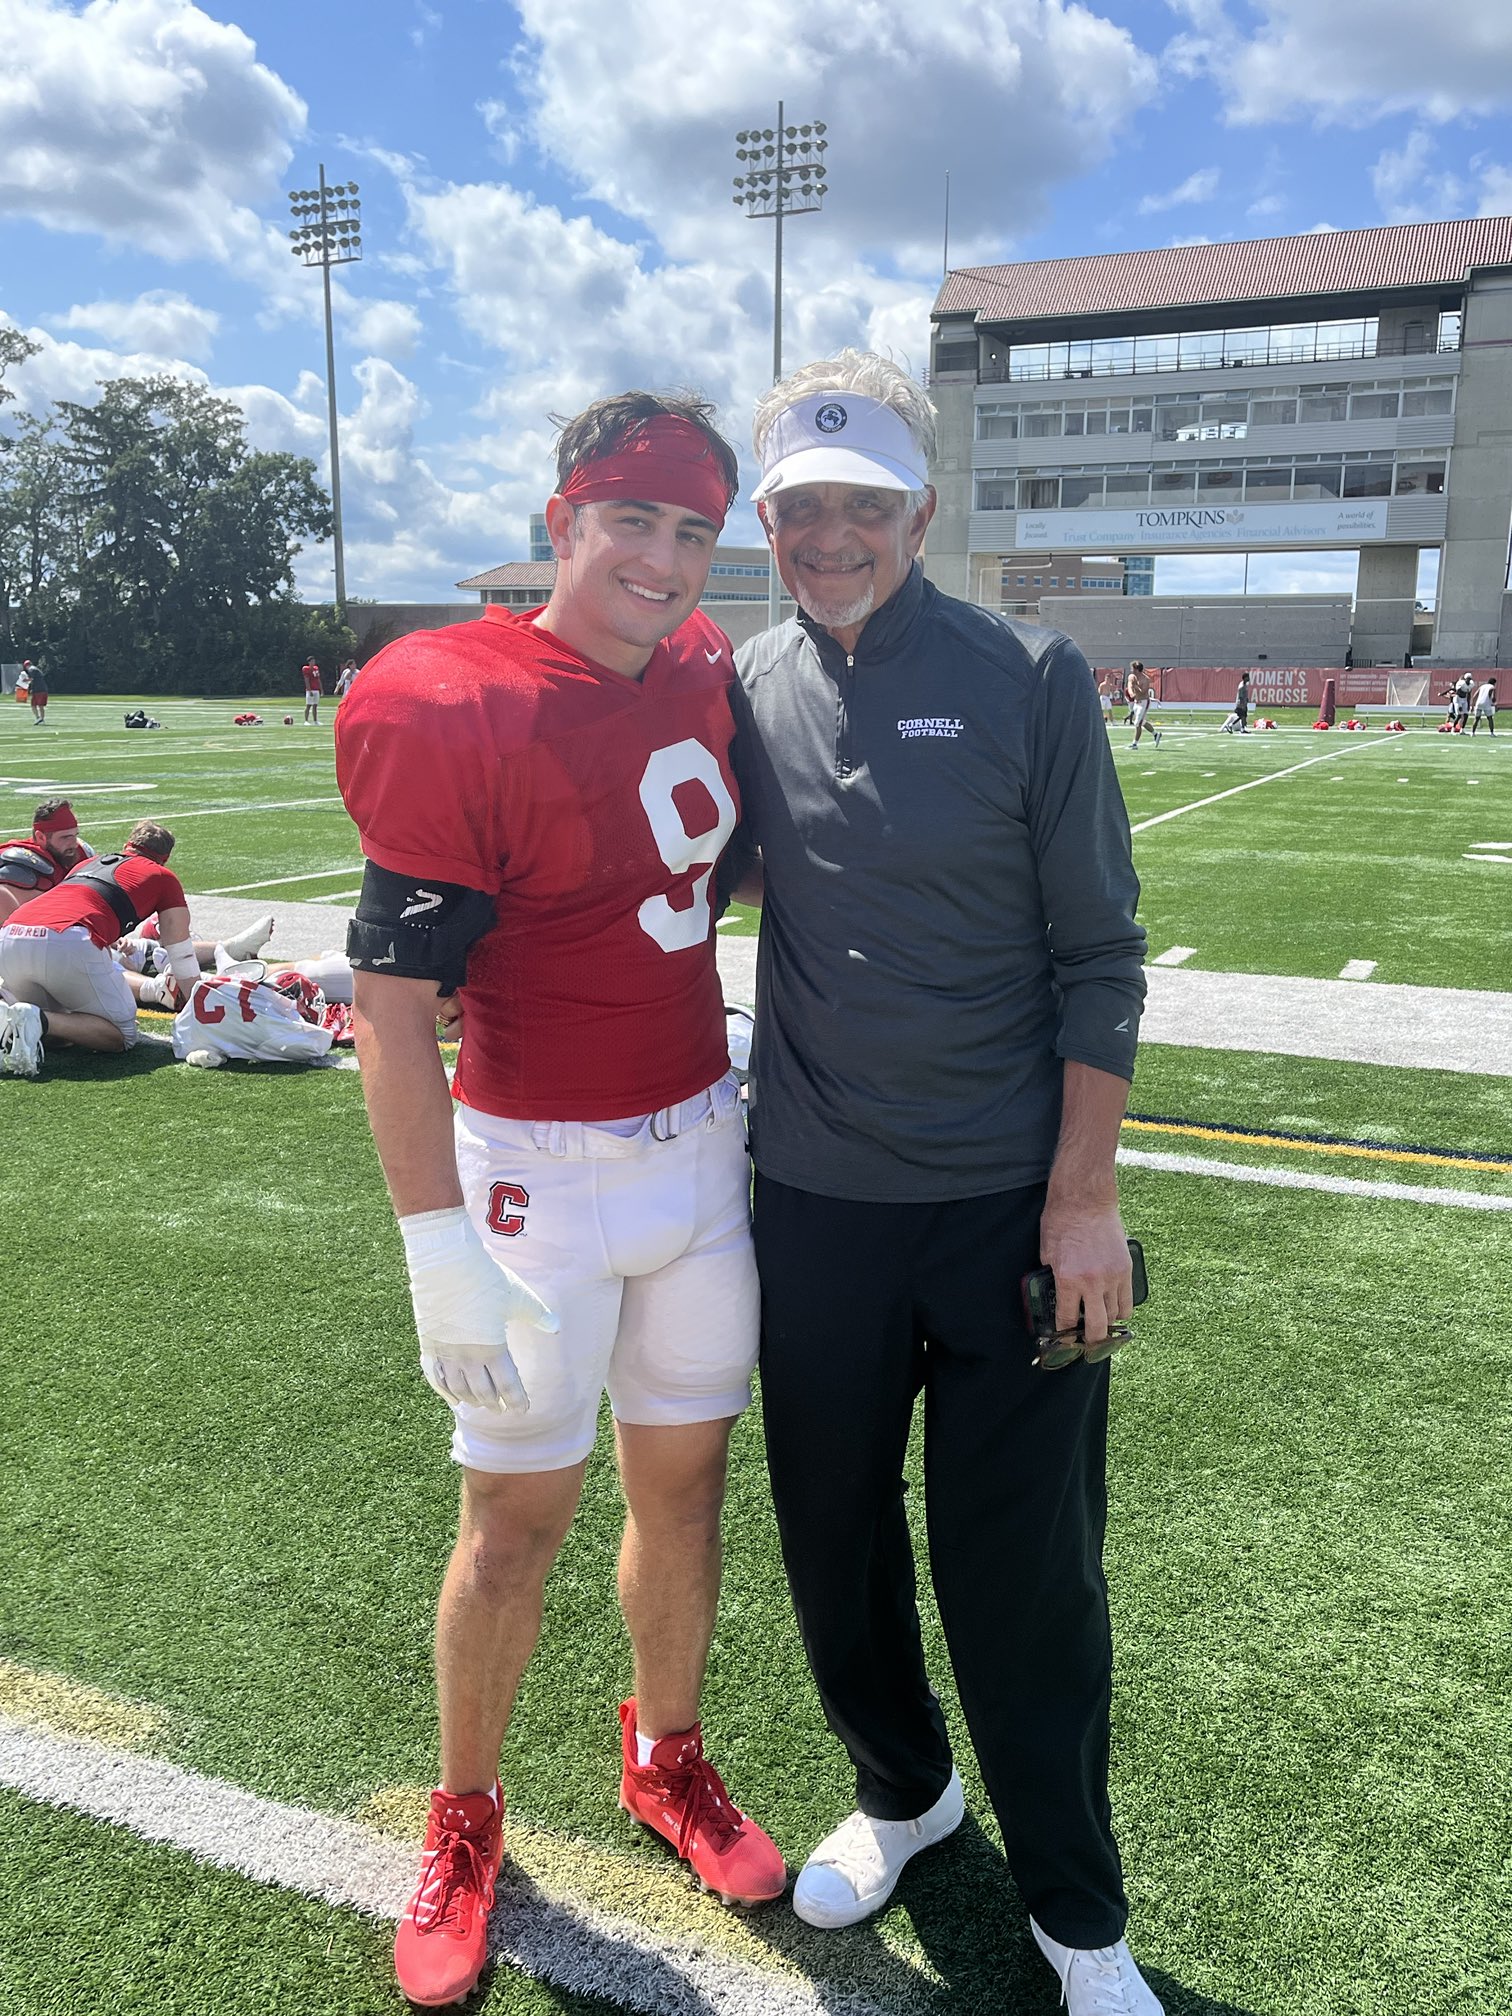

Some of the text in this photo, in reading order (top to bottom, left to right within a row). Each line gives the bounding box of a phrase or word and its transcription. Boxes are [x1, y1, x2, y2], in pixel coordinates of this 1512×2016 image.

[1136, 510, 1225, 528] TOMPKINS
[1345, 511, 1364, 519] world
[1366, 511, 1374, 521] of
[1063, 524, 1326, 544] Trust Company Insurance Agencies Financial Advisors
[1250, 687, 1309, 704] ACROSSE
[897, 718, 964, 731] CORNELL
[901, 728, 959, 739] FOOTBALL
[637, 737, 737, 954] 9
[9, 925, 47, 938] BIG RED
[486, 1181, 530, 1237] C
